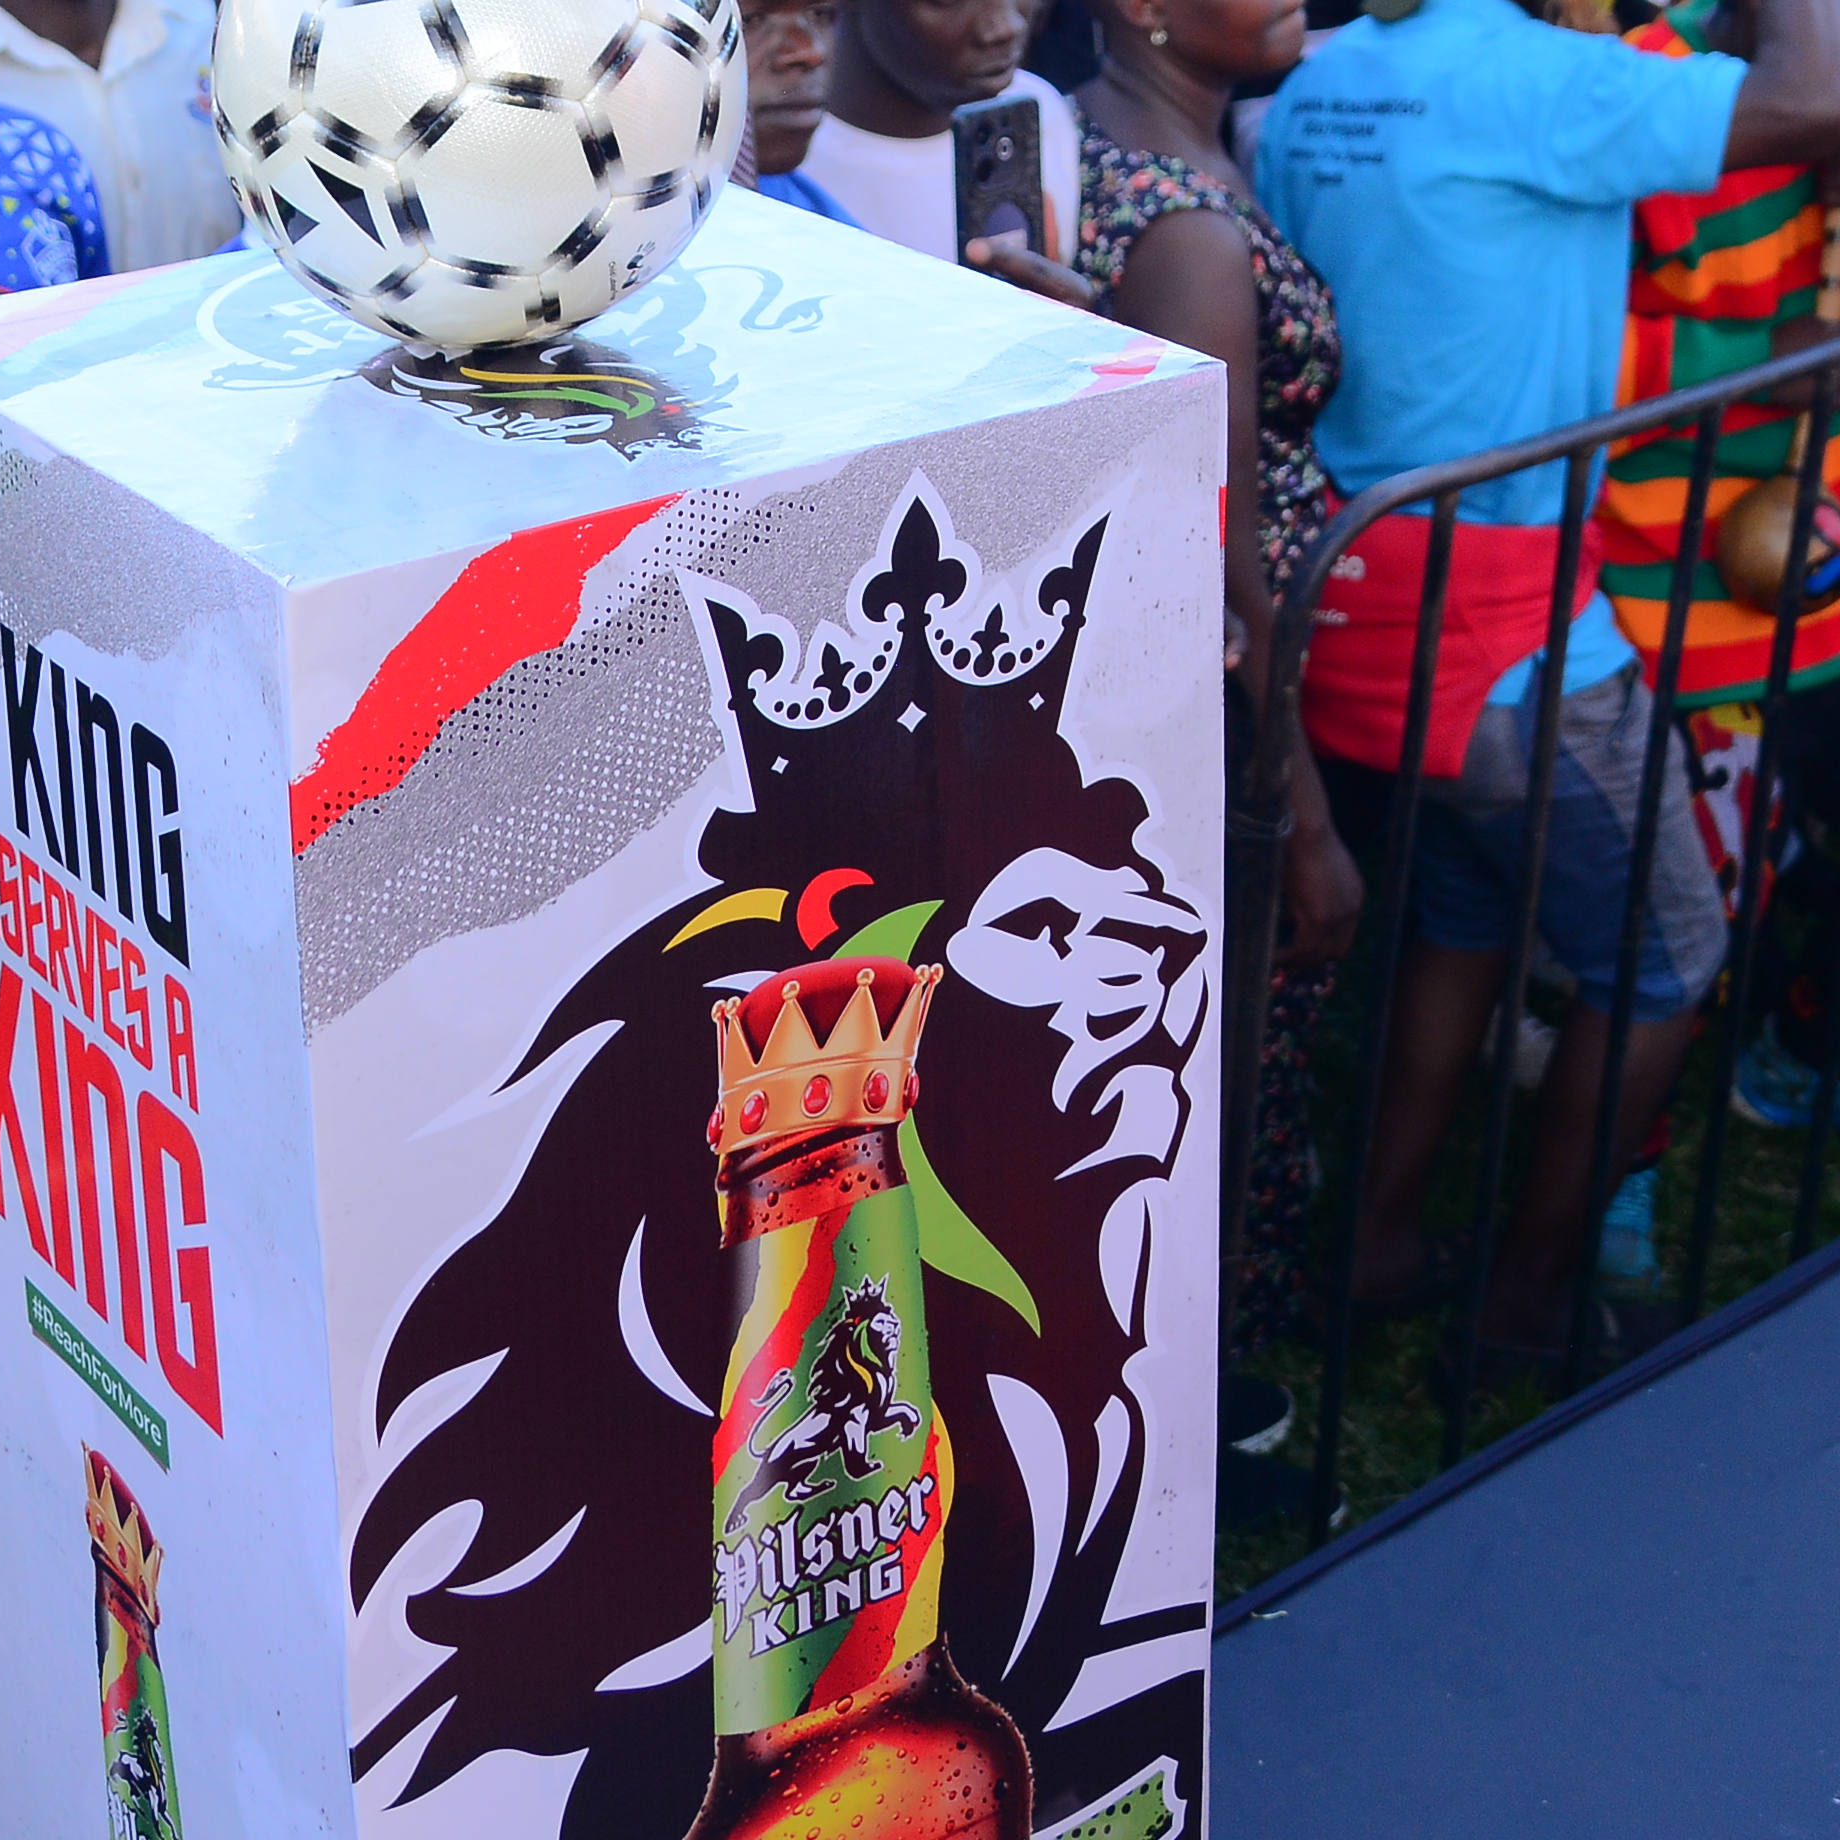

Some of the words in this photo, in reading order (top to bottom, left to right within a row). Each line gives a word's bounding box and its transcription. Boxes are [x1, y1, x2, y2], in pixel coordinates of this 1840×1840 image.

[164, 972, 200, 1115] A
[31, 1294, 163, 1448] #ReachForMore
[715, 1475, 935, 1644] Pilsner
[749, 1548, 904, 1658] KING
